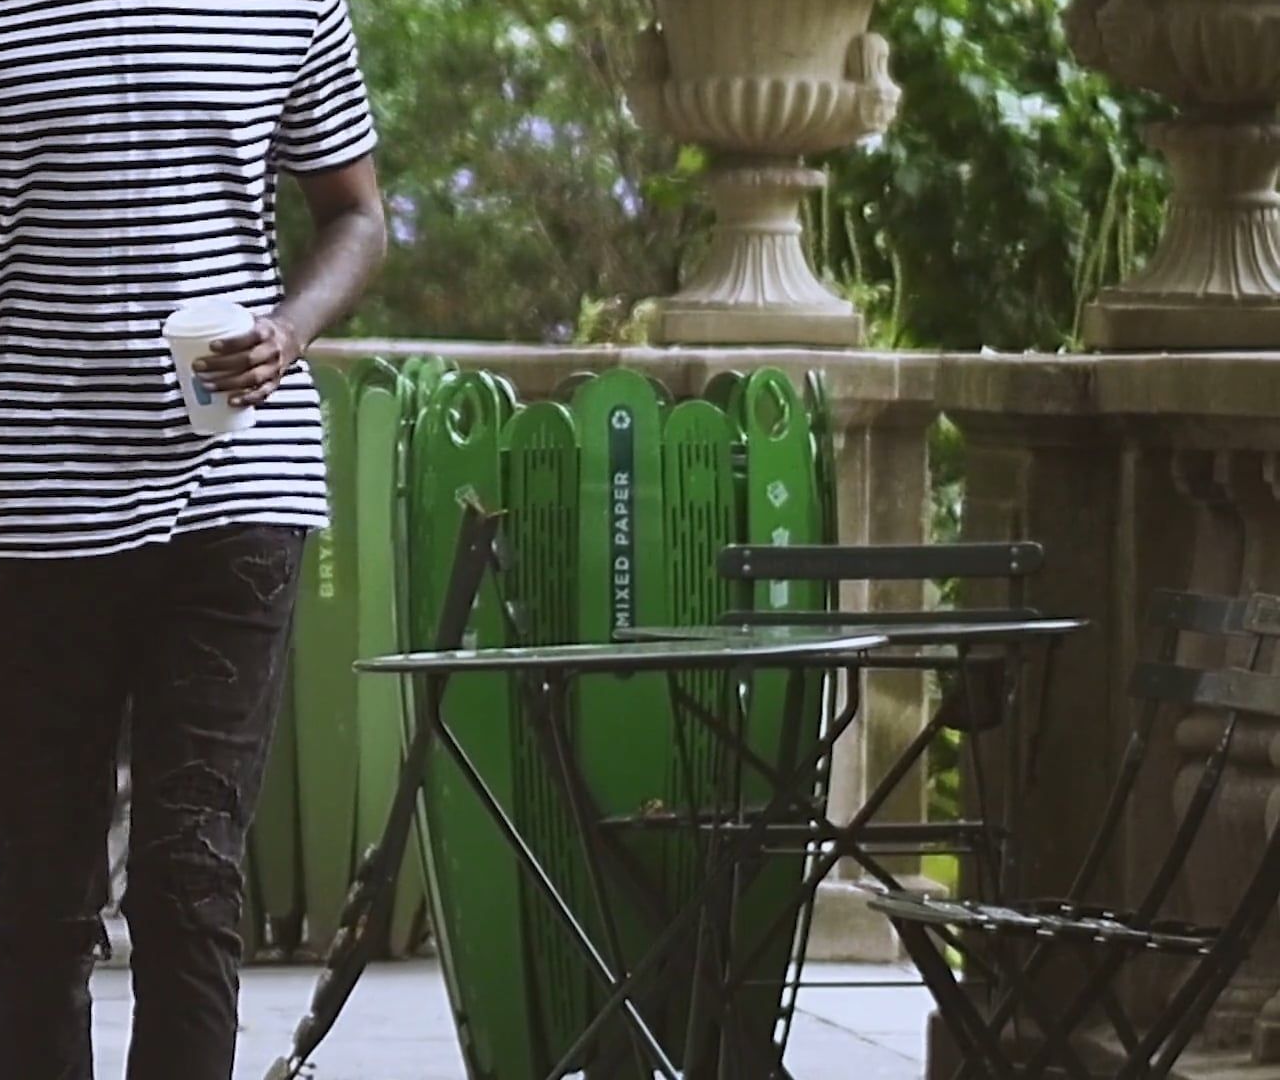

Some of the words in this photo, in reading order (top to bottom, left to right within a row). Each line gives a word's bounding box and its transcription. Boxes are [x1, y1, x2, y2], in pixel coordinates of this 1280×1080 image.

[319, 489, 335, 599] BRYA
[614, 471, 630, 546] PAPER
[615, 556, 630, 629] MIXED
